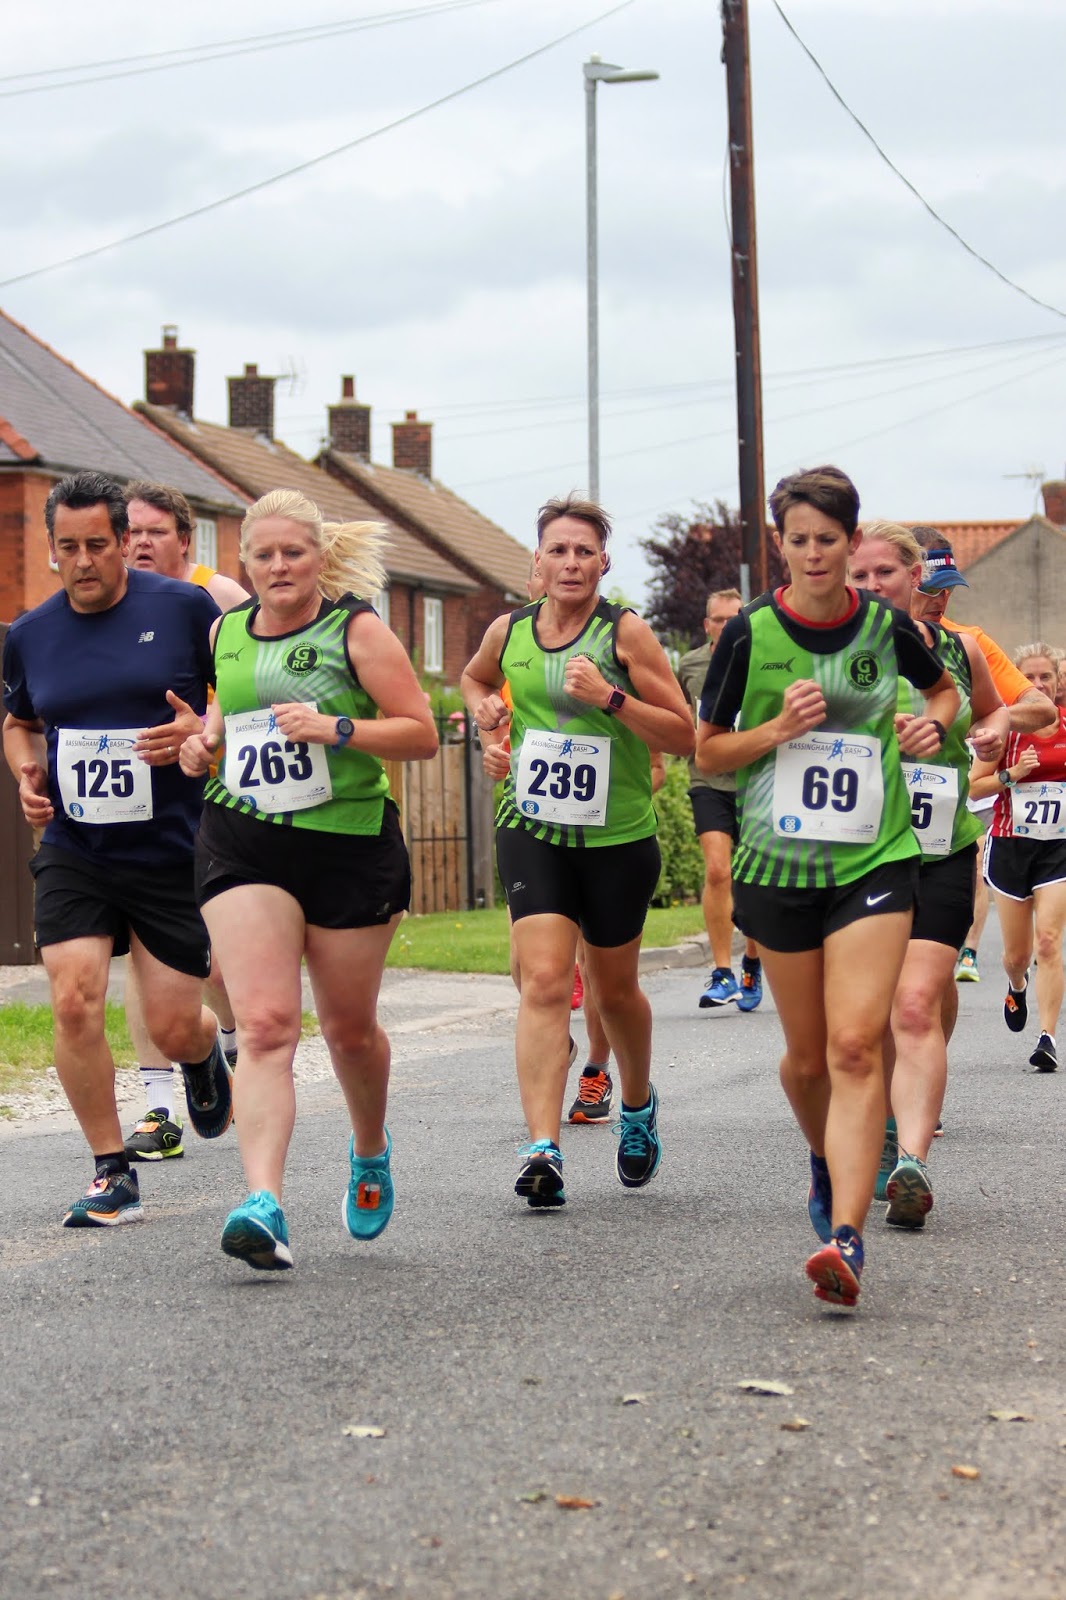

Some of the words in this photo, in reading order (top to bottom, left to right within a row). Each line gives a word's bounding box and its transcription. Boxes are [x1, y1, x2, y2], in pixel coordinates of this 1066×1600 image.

[295, 646, 310, 660] G
[292, 660, 309, 669] RC
[857, 656, 870, 673] G
[857, 673, 872, 683] RC
[235, 722, 269, 733] BASSINGHAM
[530, 740, 563, 750] BASSINGHAM
[573, 744, 588, 752] BASH
[788, 742, 832, 752] BASSINGHAM
[844, 747, 862, 755] BASH
[237, 739, 313, 788] 263
[71, 759, 134, 797] 125
[528, 759, 597, 801] 239
[802, 765, 858, 812] 69
[1024, 800, 1061, 824] 277
